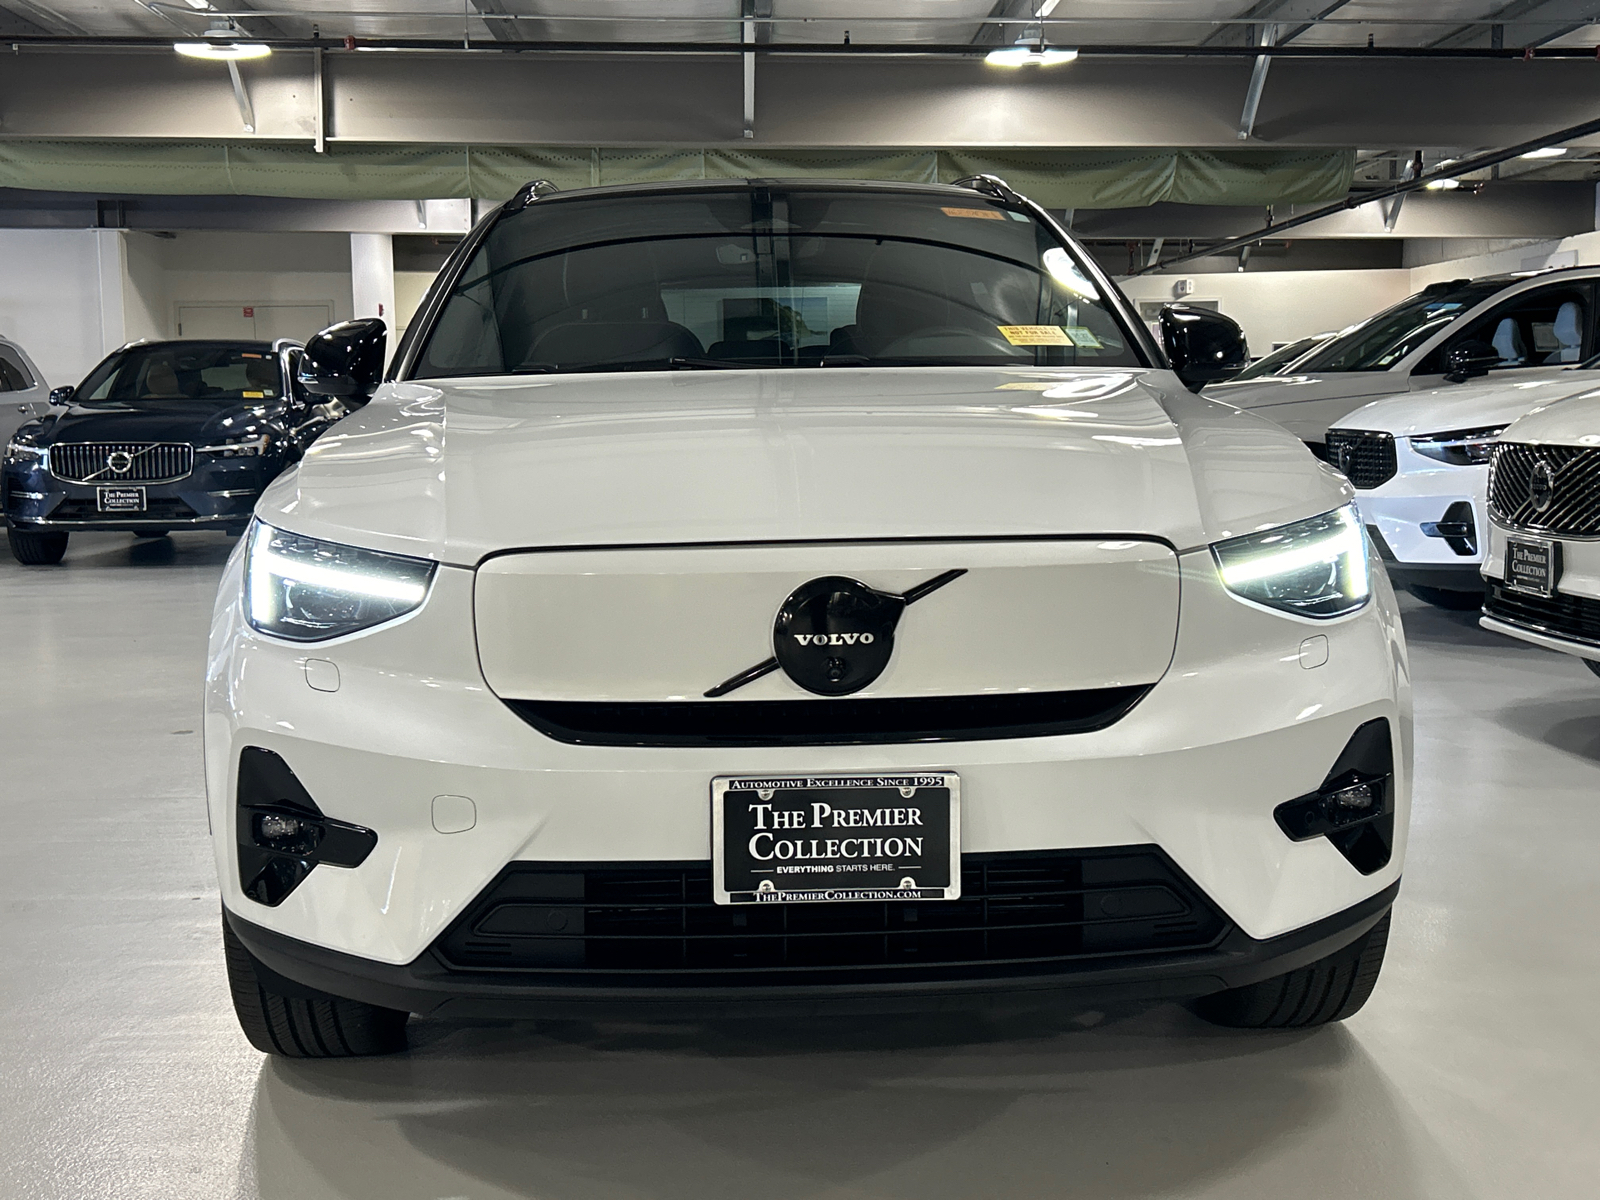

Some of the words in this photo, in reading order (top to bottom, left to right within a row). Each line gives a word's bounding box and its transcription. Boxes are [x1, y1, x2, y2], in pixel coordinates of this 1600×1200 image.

[1512, 547, 1523, 560] THE
[1523, 549, 1546, 564] PREMIER
[1512, 560, 1546, 577] COLLECTION
[794, 633, 874, 646] VOLVO
[732, 779, 803, 789] AUTOMOTIVE
[806, 778, 874, 788] EXCELLENCE
[876, 777, 909, 786] SINCE
[913, 777, 943, 786] 1995
[748, 803, 806, 830] THE
[810, 802, 923, 828] PREMIER
[749, 832, 923, 861] COLLECTION
[776, 864, 834, 874] EVERYTHING
[835, 863, 868, 872] STARTS
[870, 863, 895, 872] HERE.
